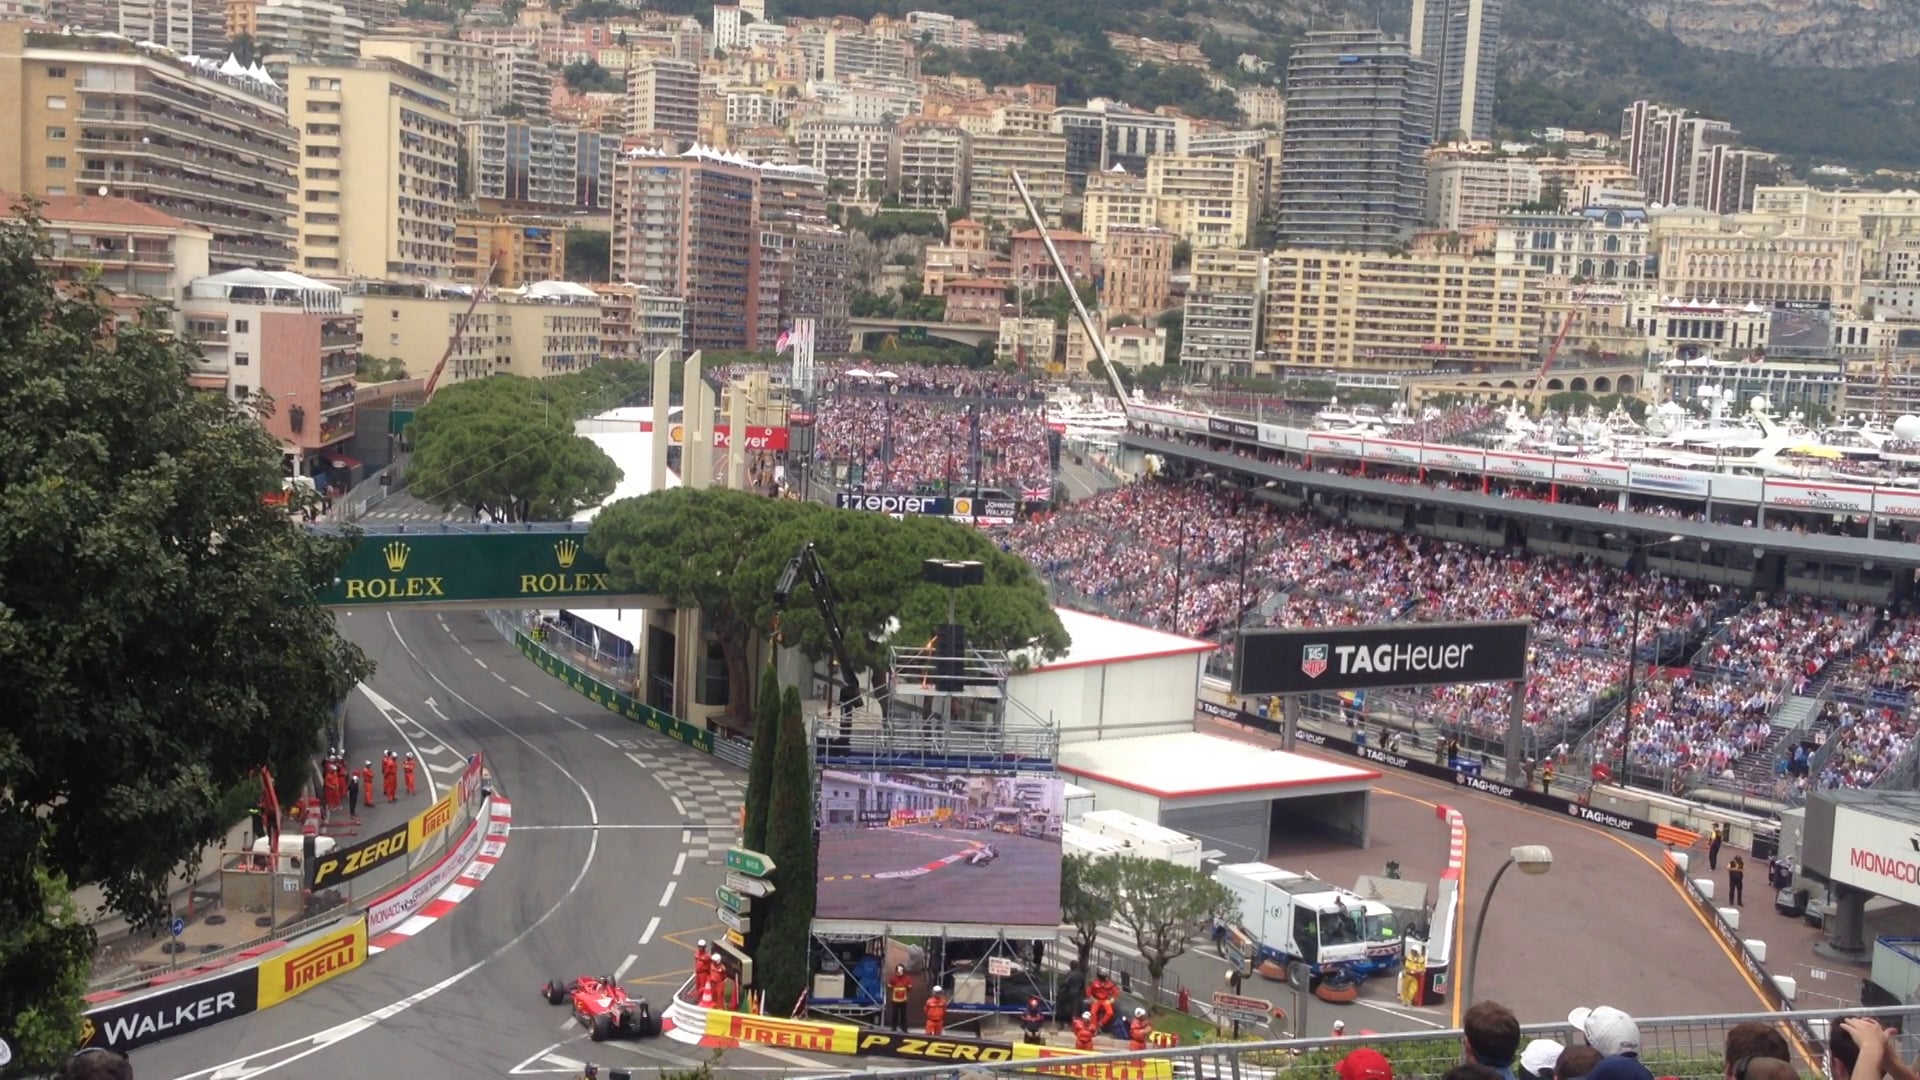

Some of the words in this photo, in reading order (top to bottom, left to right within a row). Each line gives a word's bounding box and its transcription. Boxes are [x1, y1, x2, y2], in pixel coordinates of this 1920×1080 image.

[346, 577, 444, 598] ROLEX
[520, 573, 609, 593] ROLEX
[315, 859, 338, 884] P
[341, 830, 407, 875] ZERO
[284, 933, 355, 993] PIRELLI
[104, 991, 236, 1046] WALKER
[730, 1015, 835, 1050] PIRELLI
[861, 1034, 893, 1051] P
[902, 1038, 1013, 1062] ZERO
